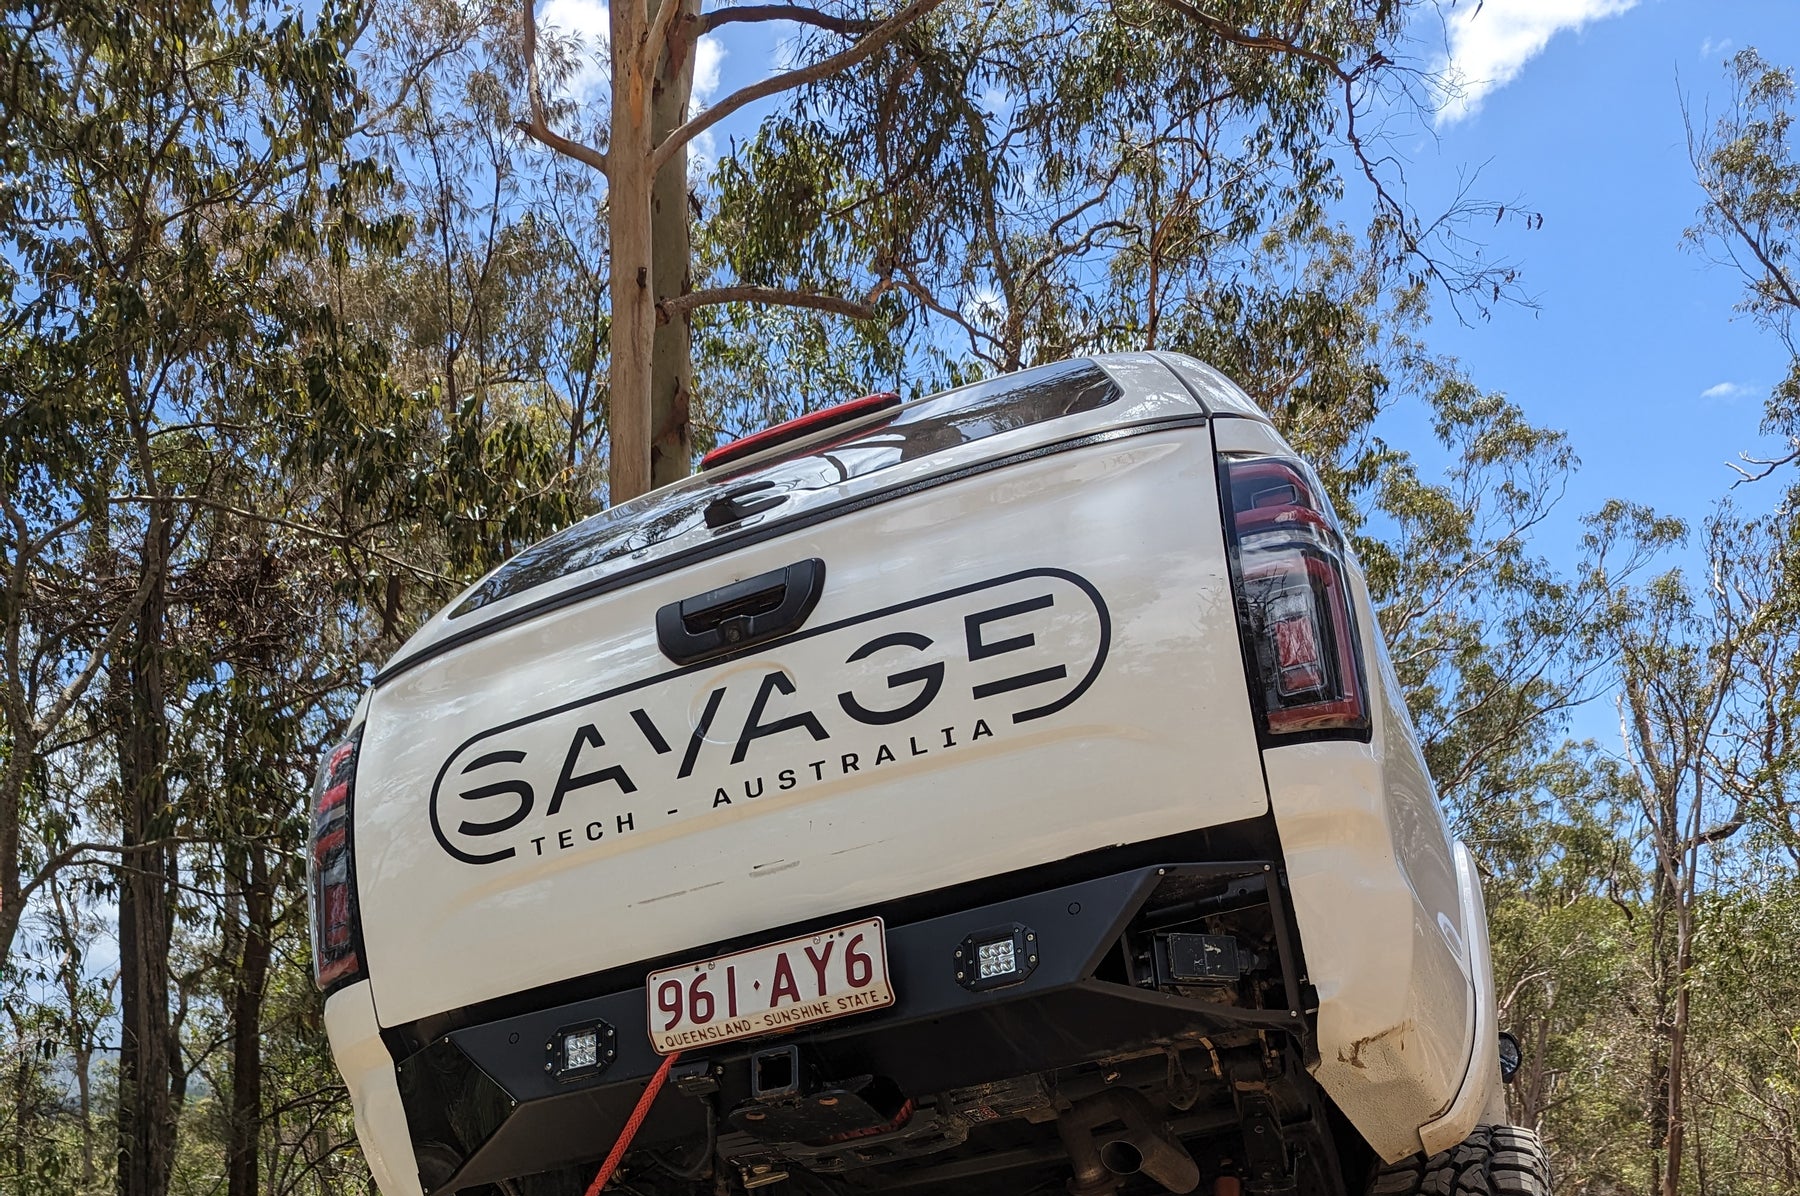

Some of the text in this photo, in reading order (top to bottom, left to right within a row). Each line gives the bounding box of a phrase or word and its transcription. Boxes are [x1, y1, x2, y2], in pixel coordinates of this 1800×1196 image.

[457, 593, 1068, 836] SAVAGE
[530, 811, 635, 857] TECH
[711, 718, 994, 808] AUSTRALIA
[664, 1019, 751, 1048] QUEENSLAND
[763, 1001, 832, 1026] SUNSHINE
[837, 990, 880, 1010] STATE
